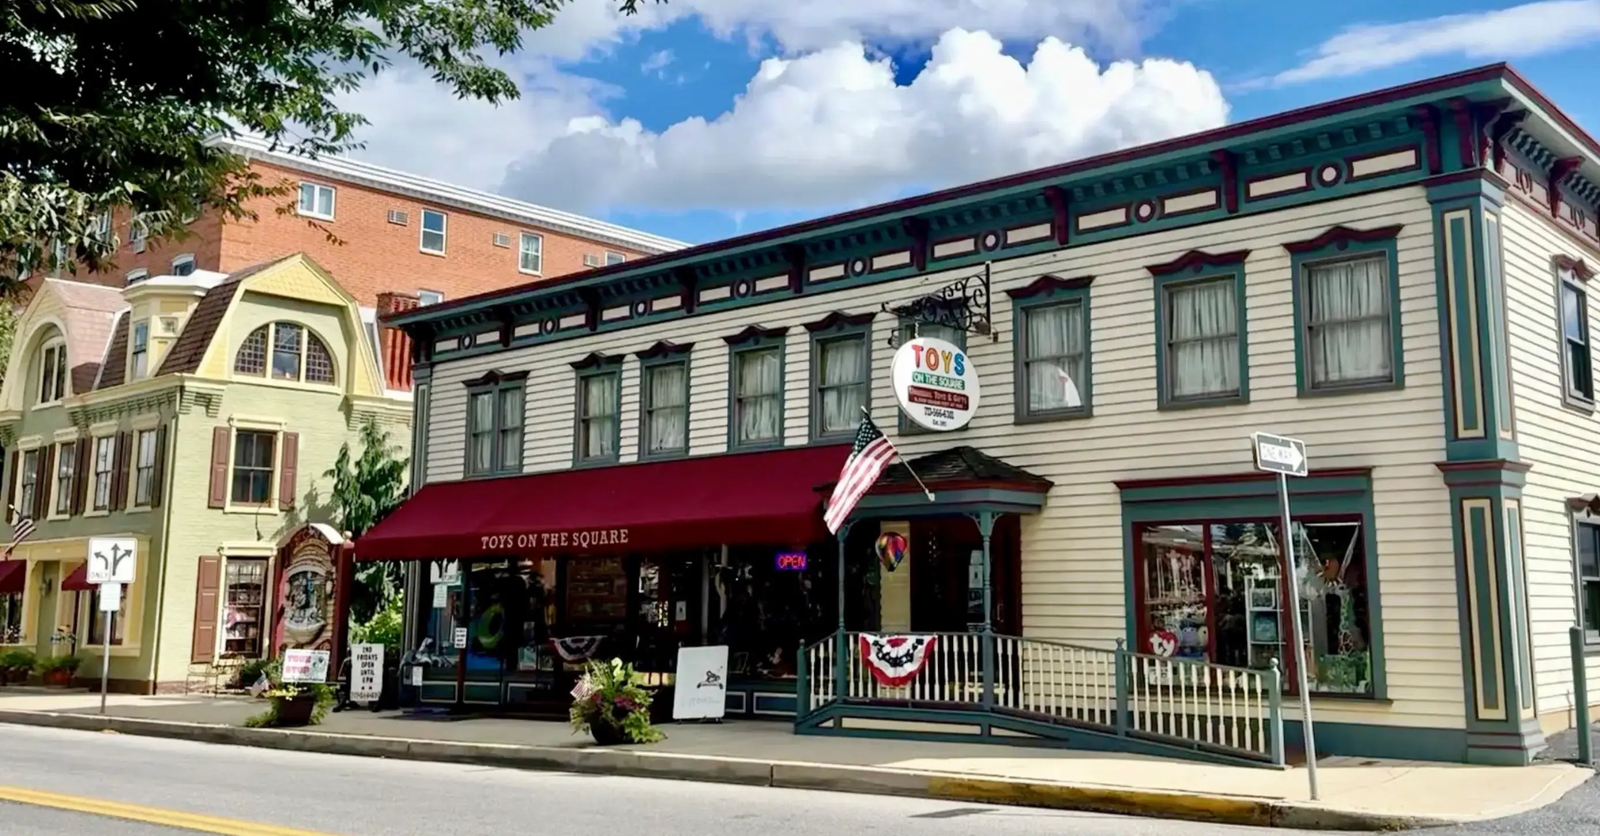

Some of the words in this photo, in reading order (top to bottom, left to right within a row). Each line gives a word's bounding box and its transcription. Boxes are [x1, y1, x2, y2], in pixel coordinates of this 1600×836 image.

[911, 344, 965, 376] TOYS
[913, 372, 924, 383] ON
[925, 373, 938, 386] THE
[939, 376, 964, 391] SQUARE
[1261, 444, 1277, 460] ONE
[481, 534, 514, 549] TOYS
[518, 534, 537, 548] ON
[542, 532, 569, 547] THE
[572, 529, 629, 548] SQUARE
[779, 555, 806, 569] OPEN
[90, 571, 108, 579] ONLY
[1149, 633, 1175, 657] ty
